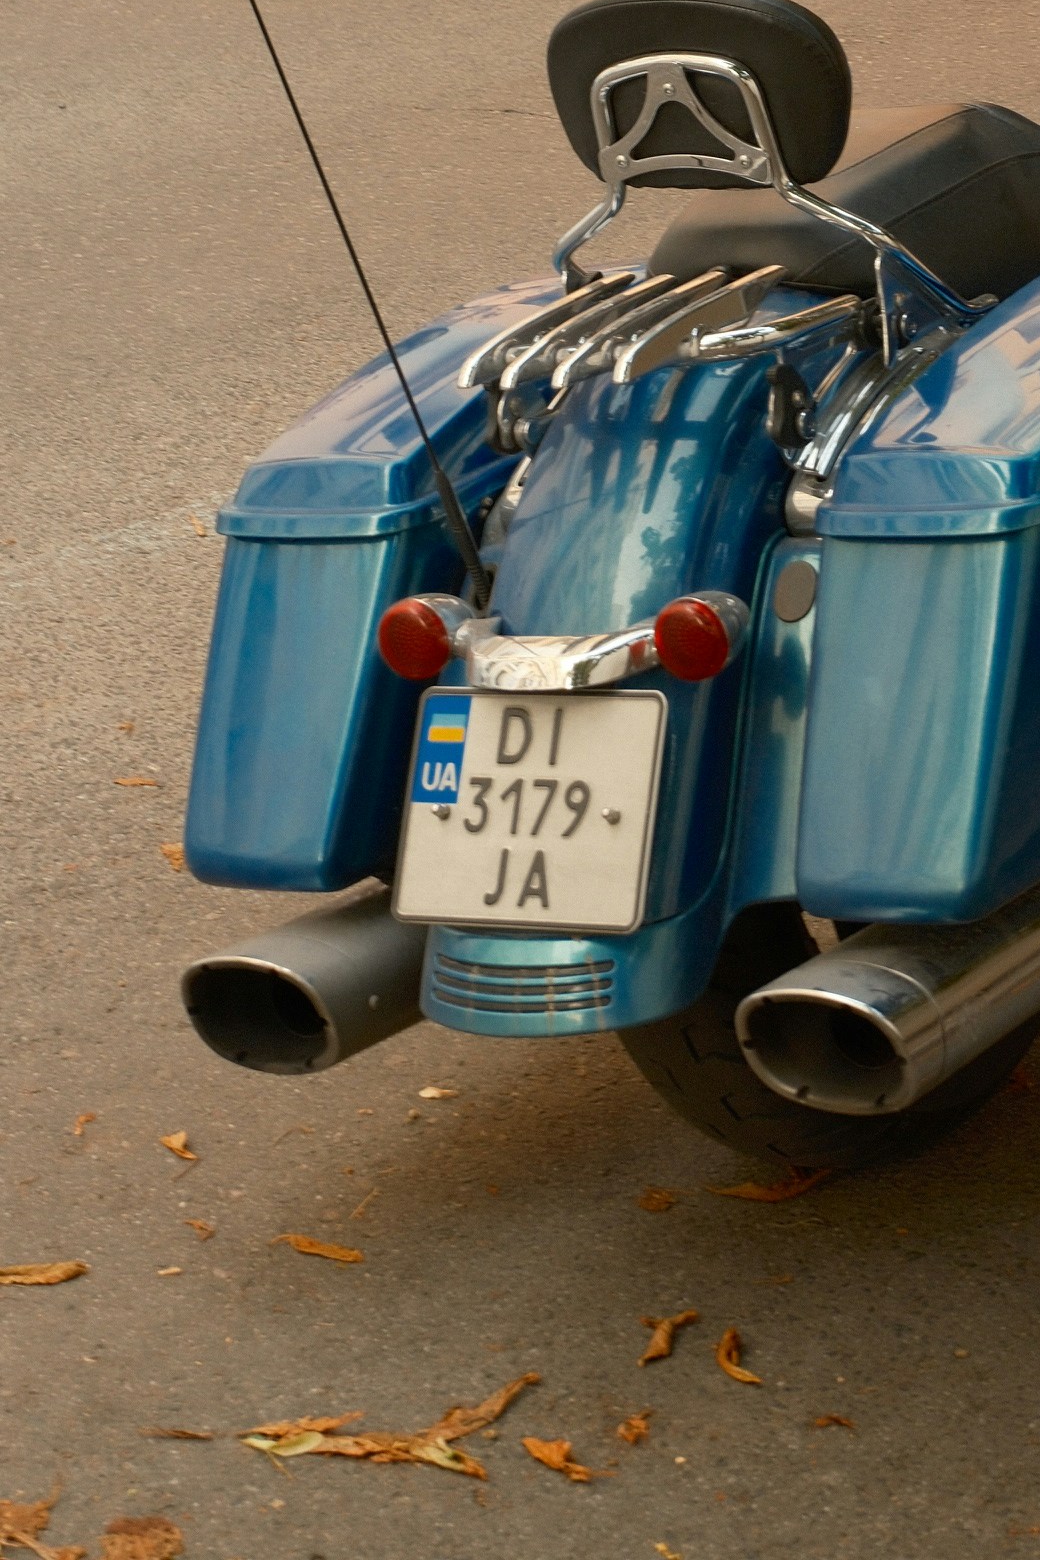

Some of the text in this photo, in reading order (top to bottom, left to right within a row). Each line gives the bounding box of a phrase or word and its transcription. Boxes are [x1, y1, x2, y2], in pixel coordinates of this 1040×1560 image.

[495, 706, 563, 766] DI
[421, 761, 458, 792] UA
[463, 776, 592, 839] 3179
[482, 847, 550, 909] JA
